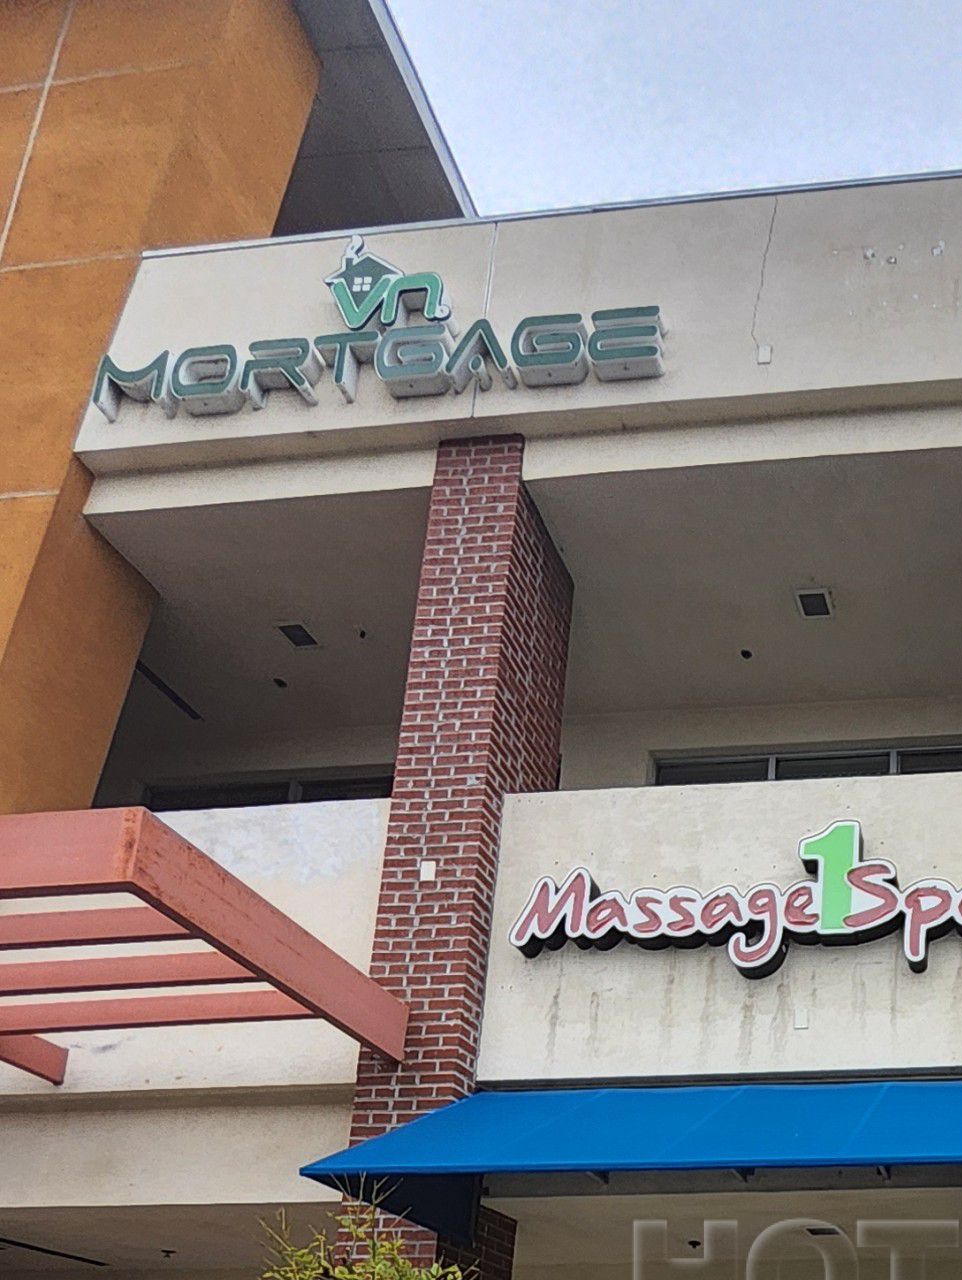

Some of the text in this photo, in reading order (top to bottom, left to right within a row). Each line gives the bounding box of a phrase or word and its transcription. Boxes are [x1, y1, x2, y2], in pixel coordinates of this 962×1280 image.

[92, 305, 661, 406] MORTGAGE
[512, 870, 820, 965] Massage
[800, 821, 859, 932] 1
